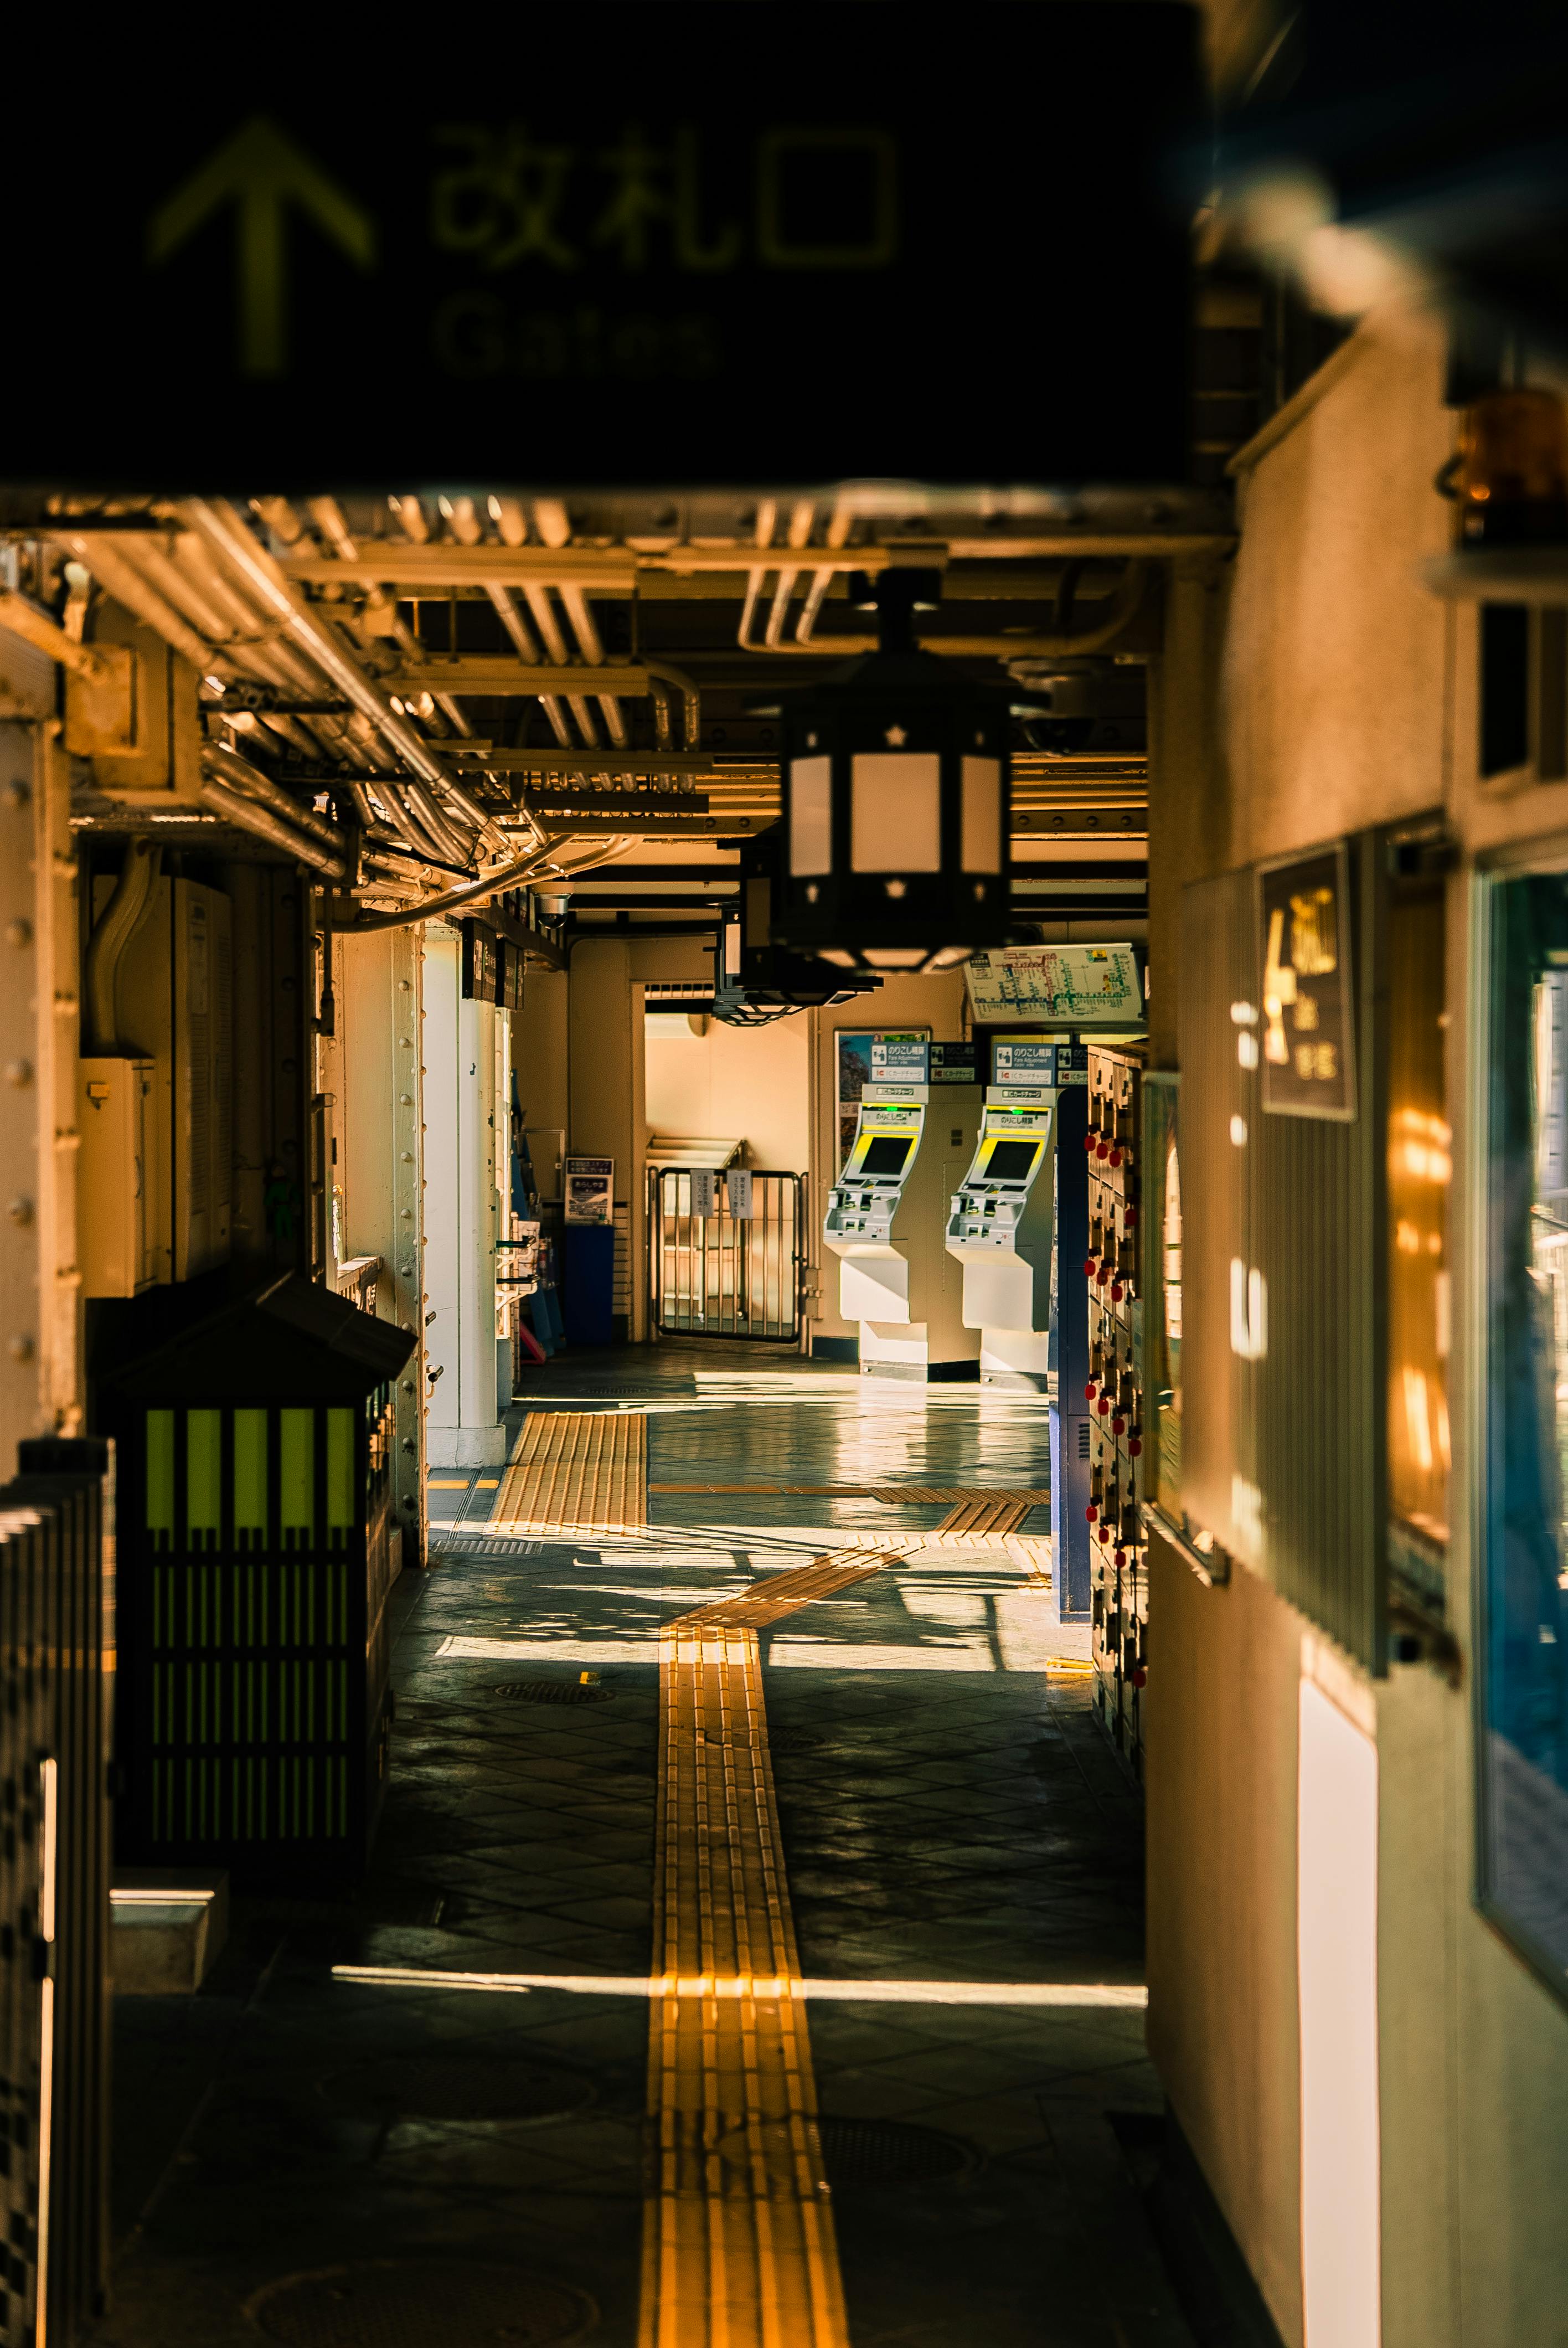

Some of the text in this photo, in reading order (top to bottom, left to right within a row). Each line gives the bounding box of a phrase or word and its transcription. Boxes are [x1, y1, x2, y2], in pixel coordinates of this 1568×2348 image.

[429, 120, 900, 272] 改札口
[432, 291, 720, 378] Gates
[888, 1046, 925, 1055] のりこし精算
[1014, 1048, 1052, 1057] のりこし精算
